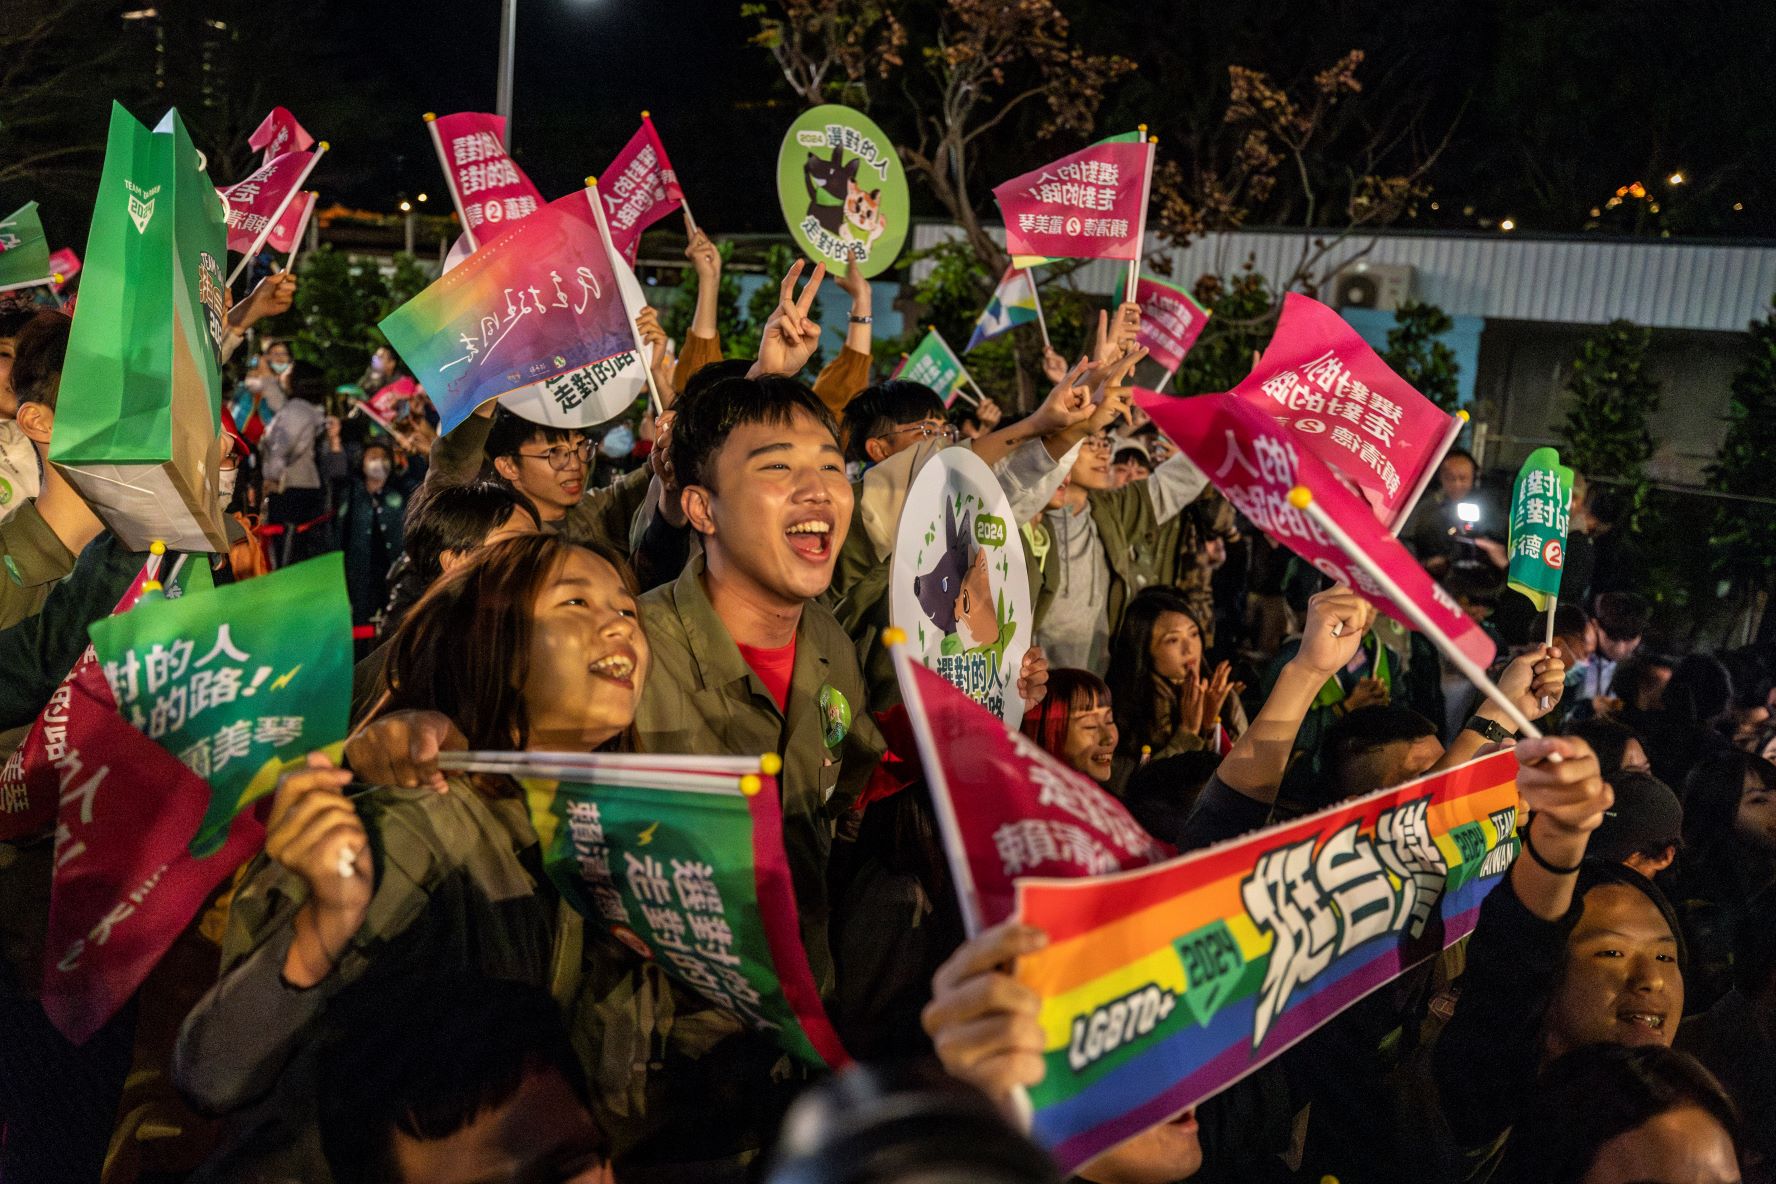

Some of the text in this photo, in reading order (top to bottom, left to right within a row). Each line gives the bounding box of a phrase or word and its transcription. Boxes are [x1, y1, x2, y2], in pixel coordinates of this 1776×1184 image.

[977, 521, 1003, 541] 2024
[1181, 927, 1241, 988] 2024
[1068, 985, 1177, 1070] LGBTQ+
